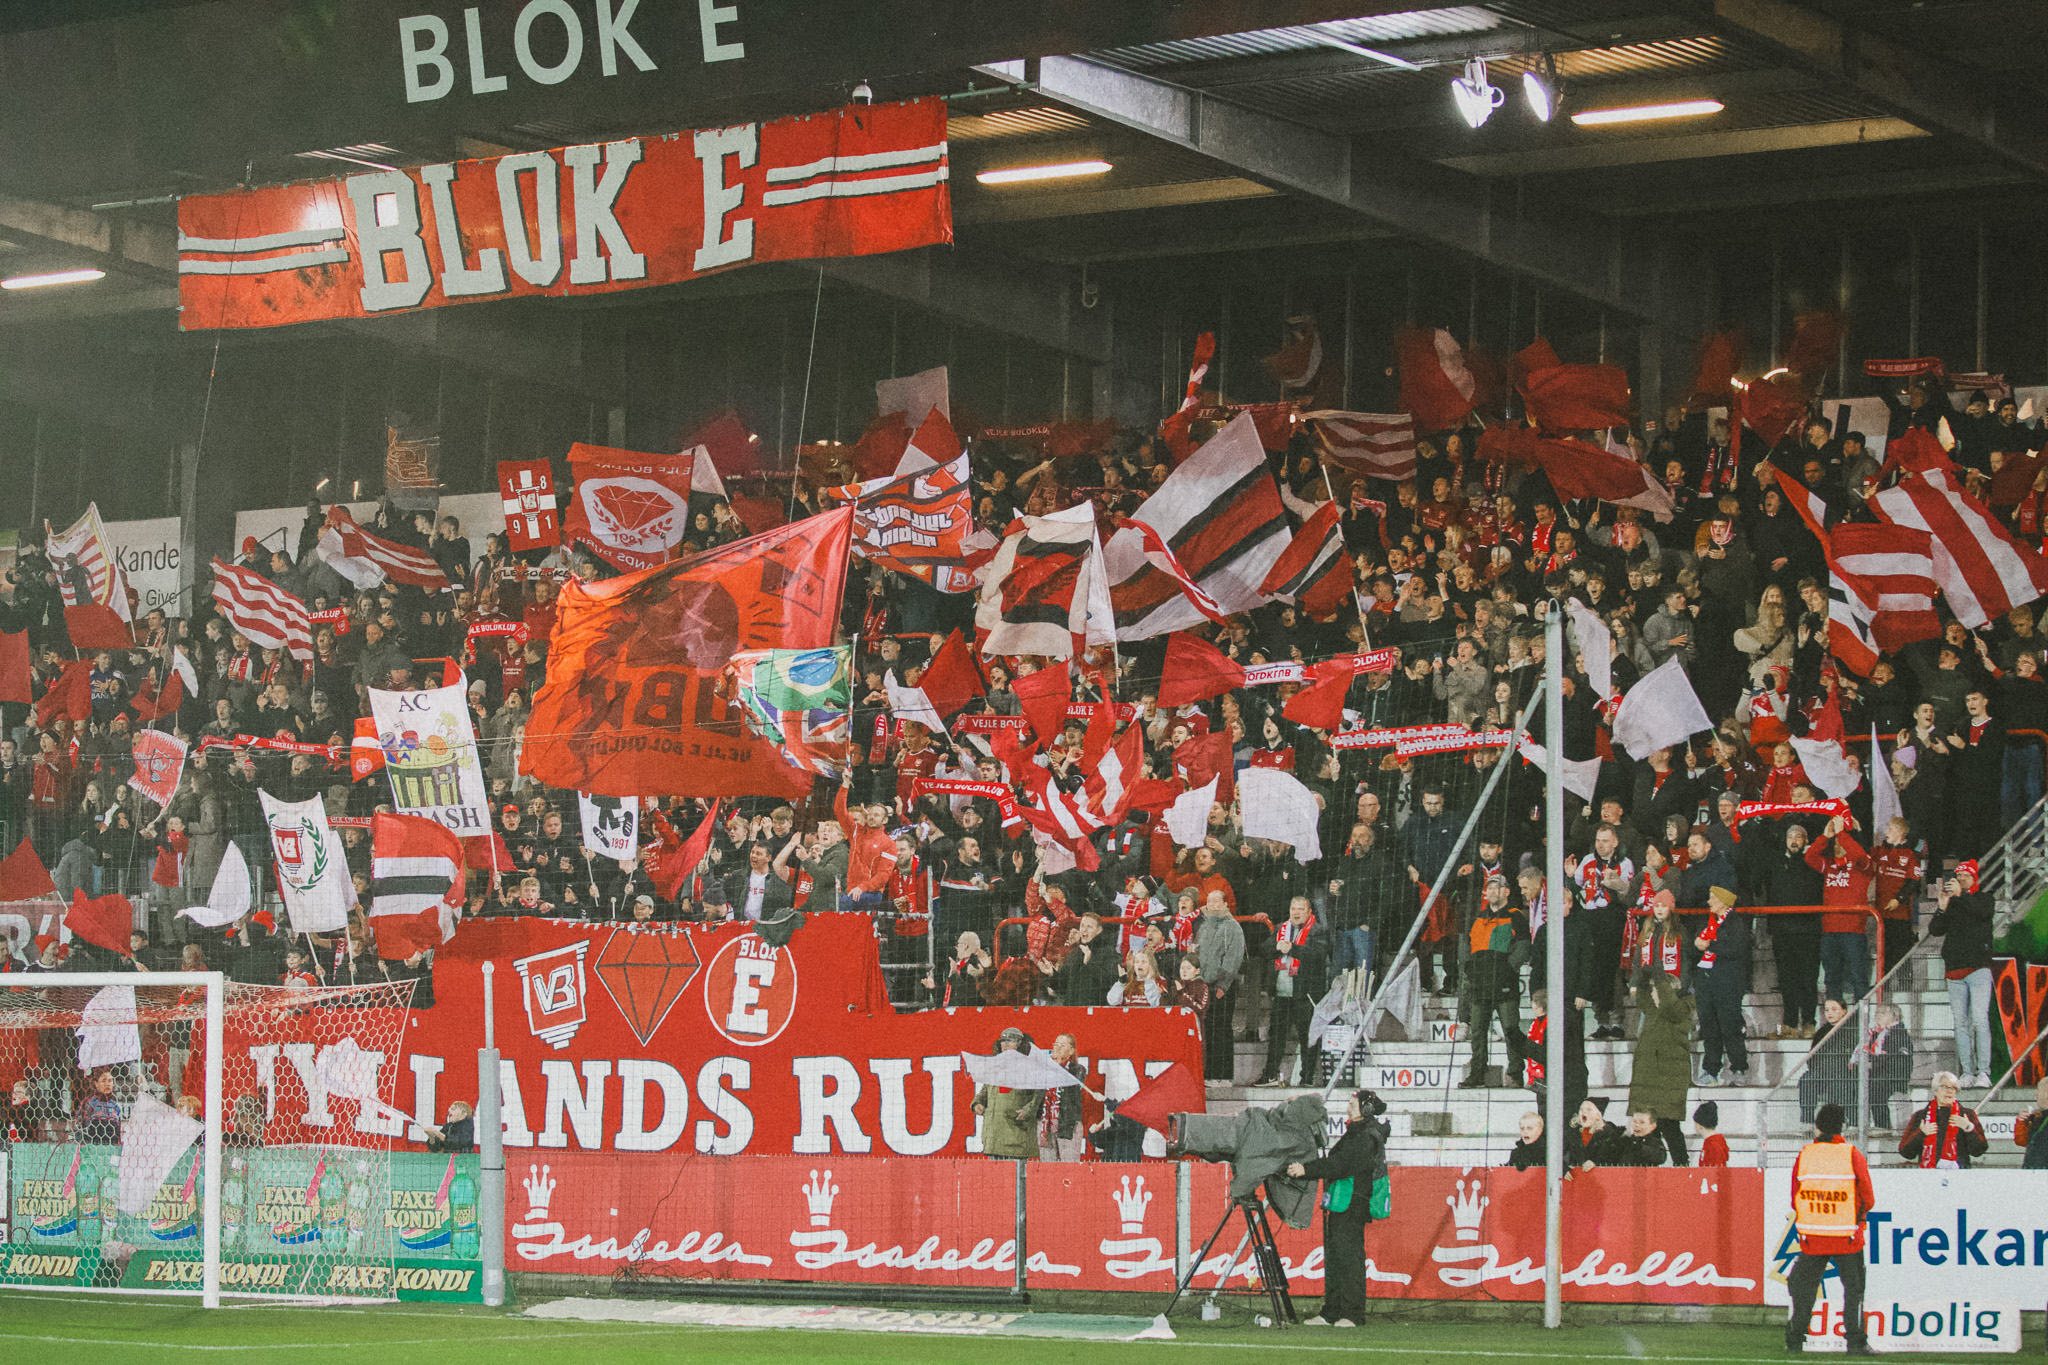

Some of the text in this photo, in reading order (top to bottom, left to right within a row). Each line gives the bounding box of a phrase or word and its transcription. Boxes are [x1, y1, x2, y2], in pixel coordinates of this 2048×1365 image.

[399, 0, 745, 103] BLOK E
[345, 121, 758, 312] BLOK E
[507, 475, 548, 492] 1 8
[512, 515, 552, 534] 9 1
[115, 542, 180, 573] Kande
[146, 588, 178, 607] Give
[398, 694, 431, 713] AC
[972, 718, 997, 728] VEJLE
[1739, 803, 1773, 815] VEJLE
[611, 838, 629, 850] 1891
[738, 939, 780, 961] BLOK
[533, 964, 577, 1015] VB
[726, 957, 777, 1036] E
[24, 1180, 64, 1198] FAXE
[153, 1184, 185, 1201] AXE
[264, 1186, 307, 1205] FAXE
[1800, 1190, 1848, 1202] STEWARD
[17, 1198, 70, 1216] KONDI
[391, 1190, 437, 1210] FAXE
[1809, 1203, 1837, 1214] 1181
[256, 1204, 313, 1224] KONDI
[384, 1210, 442, 1229] KONDI
[511, 1222, 773, 1267] Isabella
[789, 1230, 1082, 1278] Isabella
[6, 1254, 82, 1277] KONDI
[144, 1260, 291, 1286] FAXE KONDI
[326, 1264, 475, 1292] FAXE KONDI
